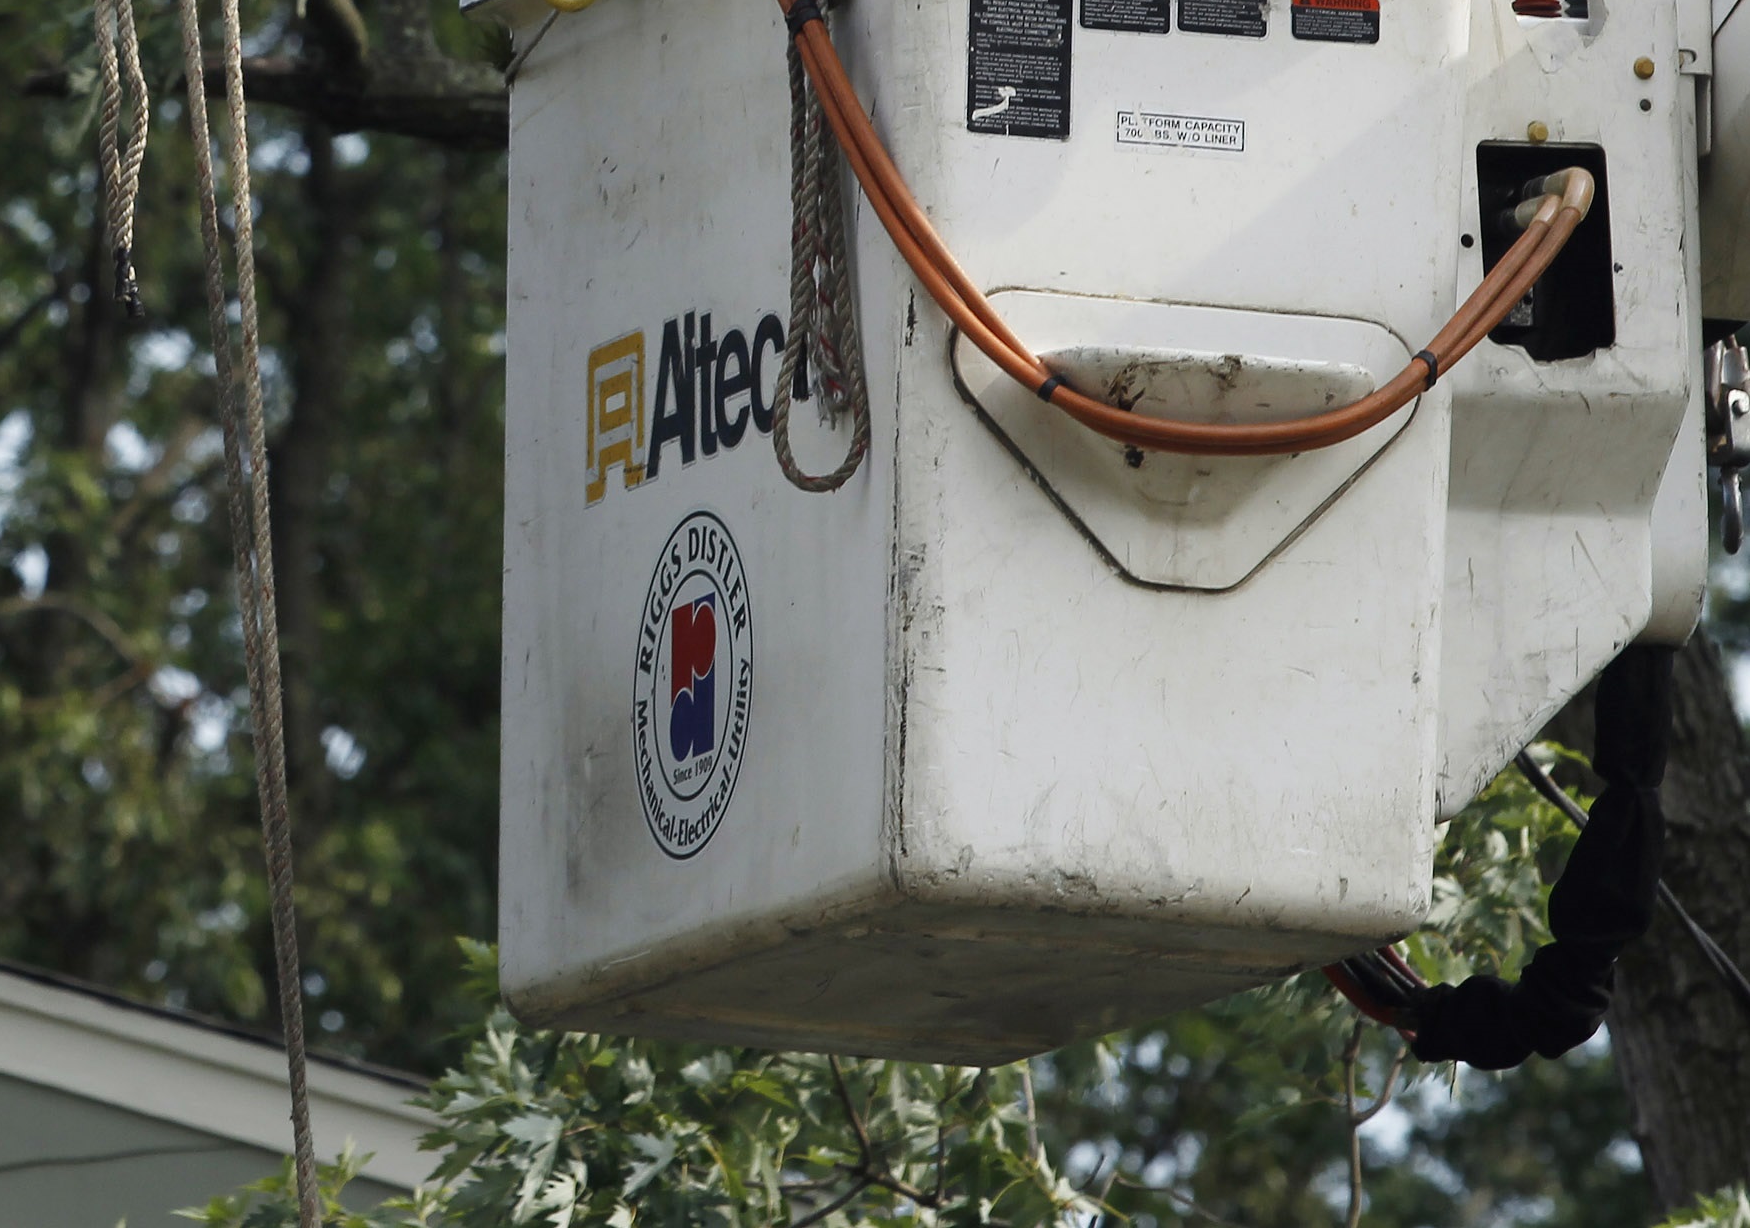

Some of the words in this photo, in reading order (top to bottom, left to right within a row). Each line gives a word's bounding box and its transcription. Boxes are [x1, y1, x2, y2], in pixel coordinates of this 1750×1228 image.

[1121, 115, 1180, 130] PLTFORM
[1185, 120, 1241, 134] CAPACITY
[1177, 131, 1200, 142] W/O
[1205, 133, 1237, 145] LINER
[645, 311, 786, 480] Altec
[639, 542, 682, 675] RIGGS
[687, 525, 747, 642] DISTLER
[672, 766, 693, 786] Since
[694, 754, 714, 777] 1909
